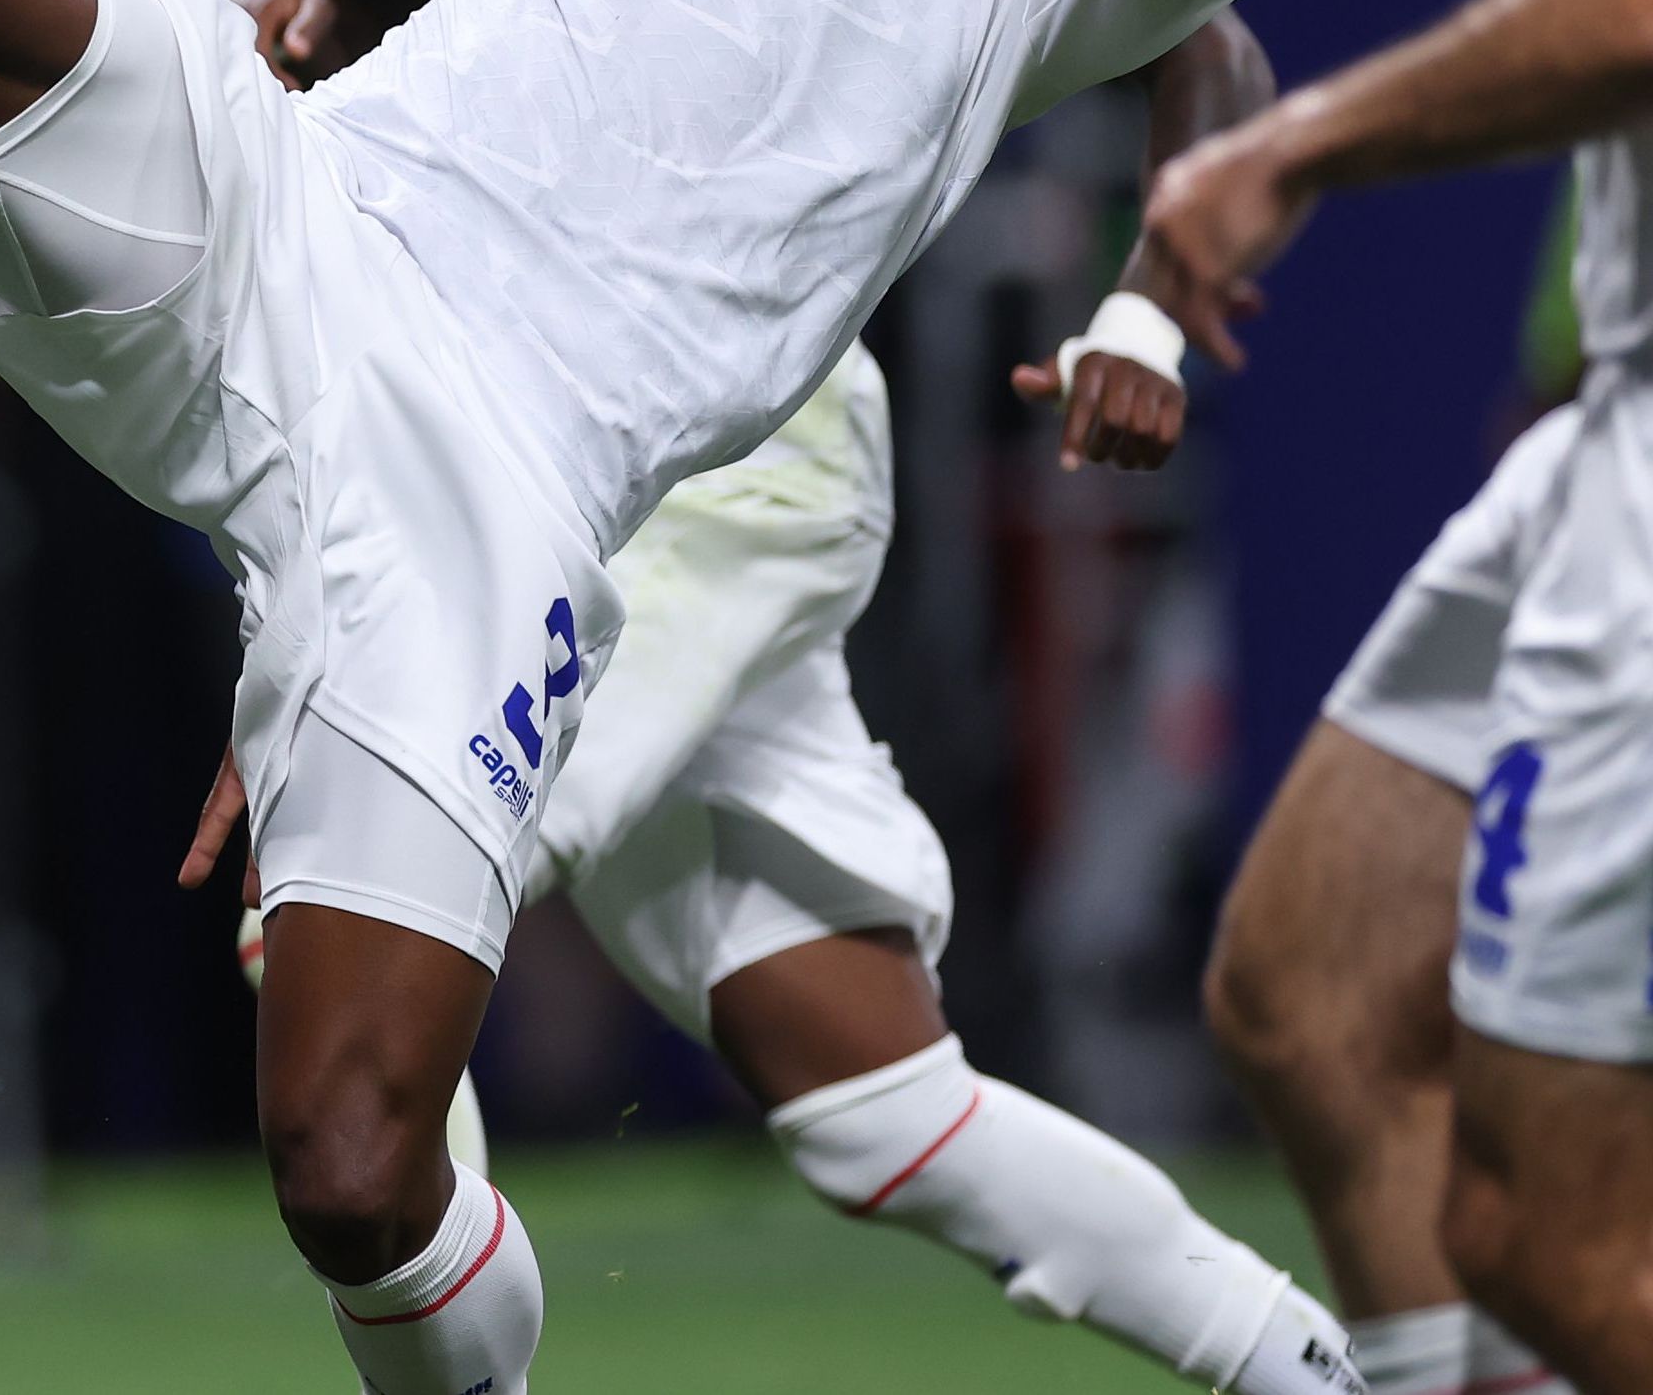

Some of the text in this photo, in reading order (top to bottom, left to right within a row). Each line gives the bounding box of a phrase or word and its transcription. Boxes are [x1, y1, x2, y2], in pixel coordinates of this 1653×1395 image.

[502, 596, 581, 770] 3
[468, 734, 534, 818] capelli
[1473, 739, 1543, 920] 4
